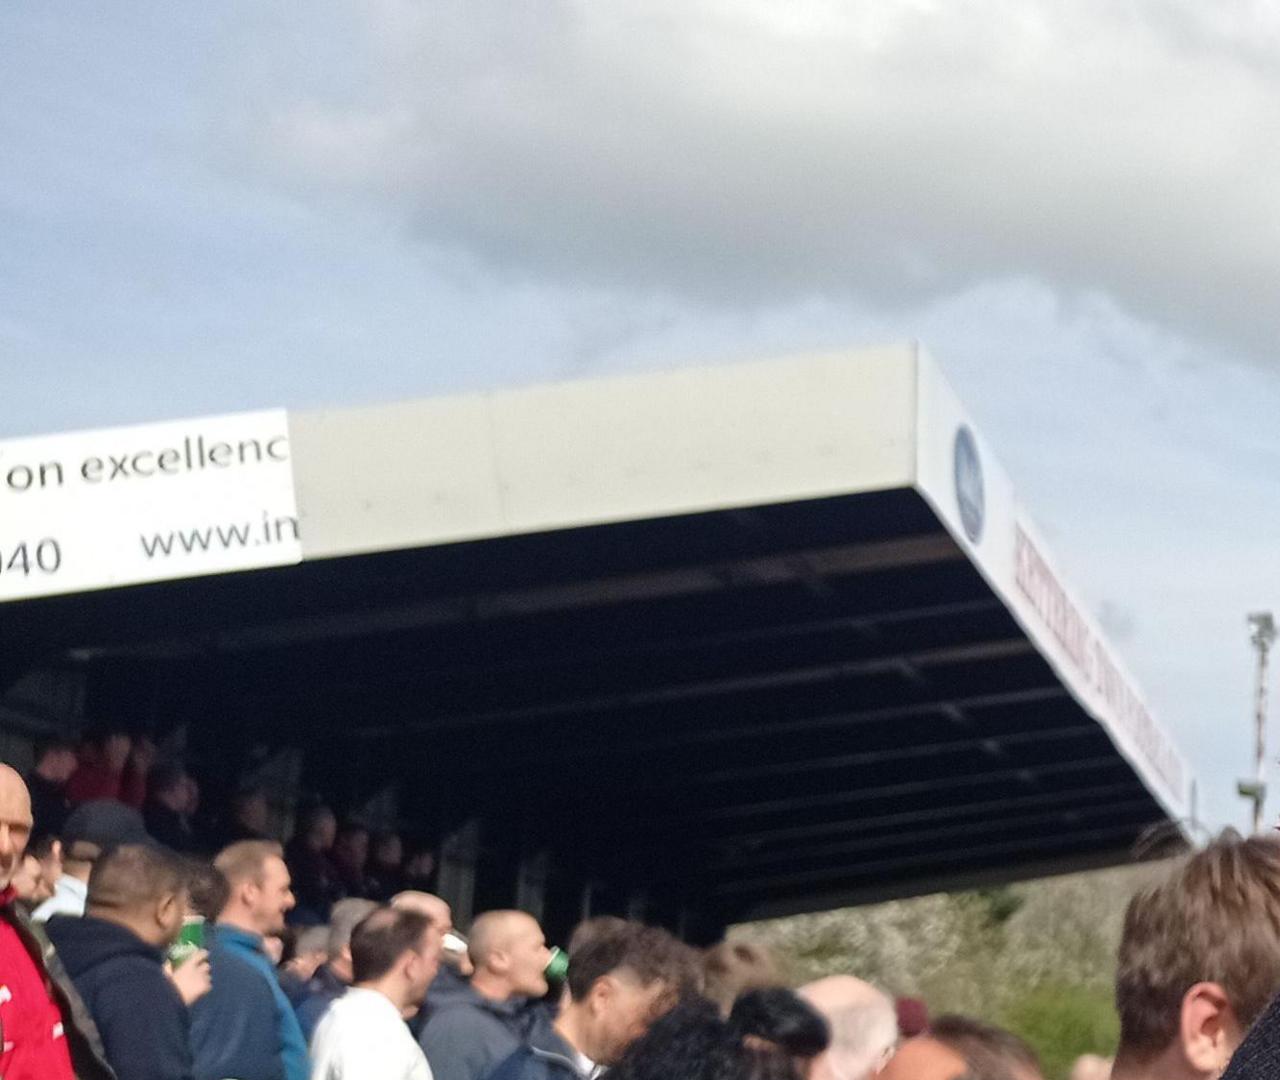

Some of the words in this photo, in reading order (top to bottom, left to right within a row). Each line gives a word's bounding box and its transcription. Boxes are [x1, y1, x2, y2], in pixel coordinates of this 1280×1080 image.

[7, 461, 63, 491] on
[81, 436, 288, 482] excellenc
[0, 537, 61, 577] 40
[140, 510, 299, 558] www.in
